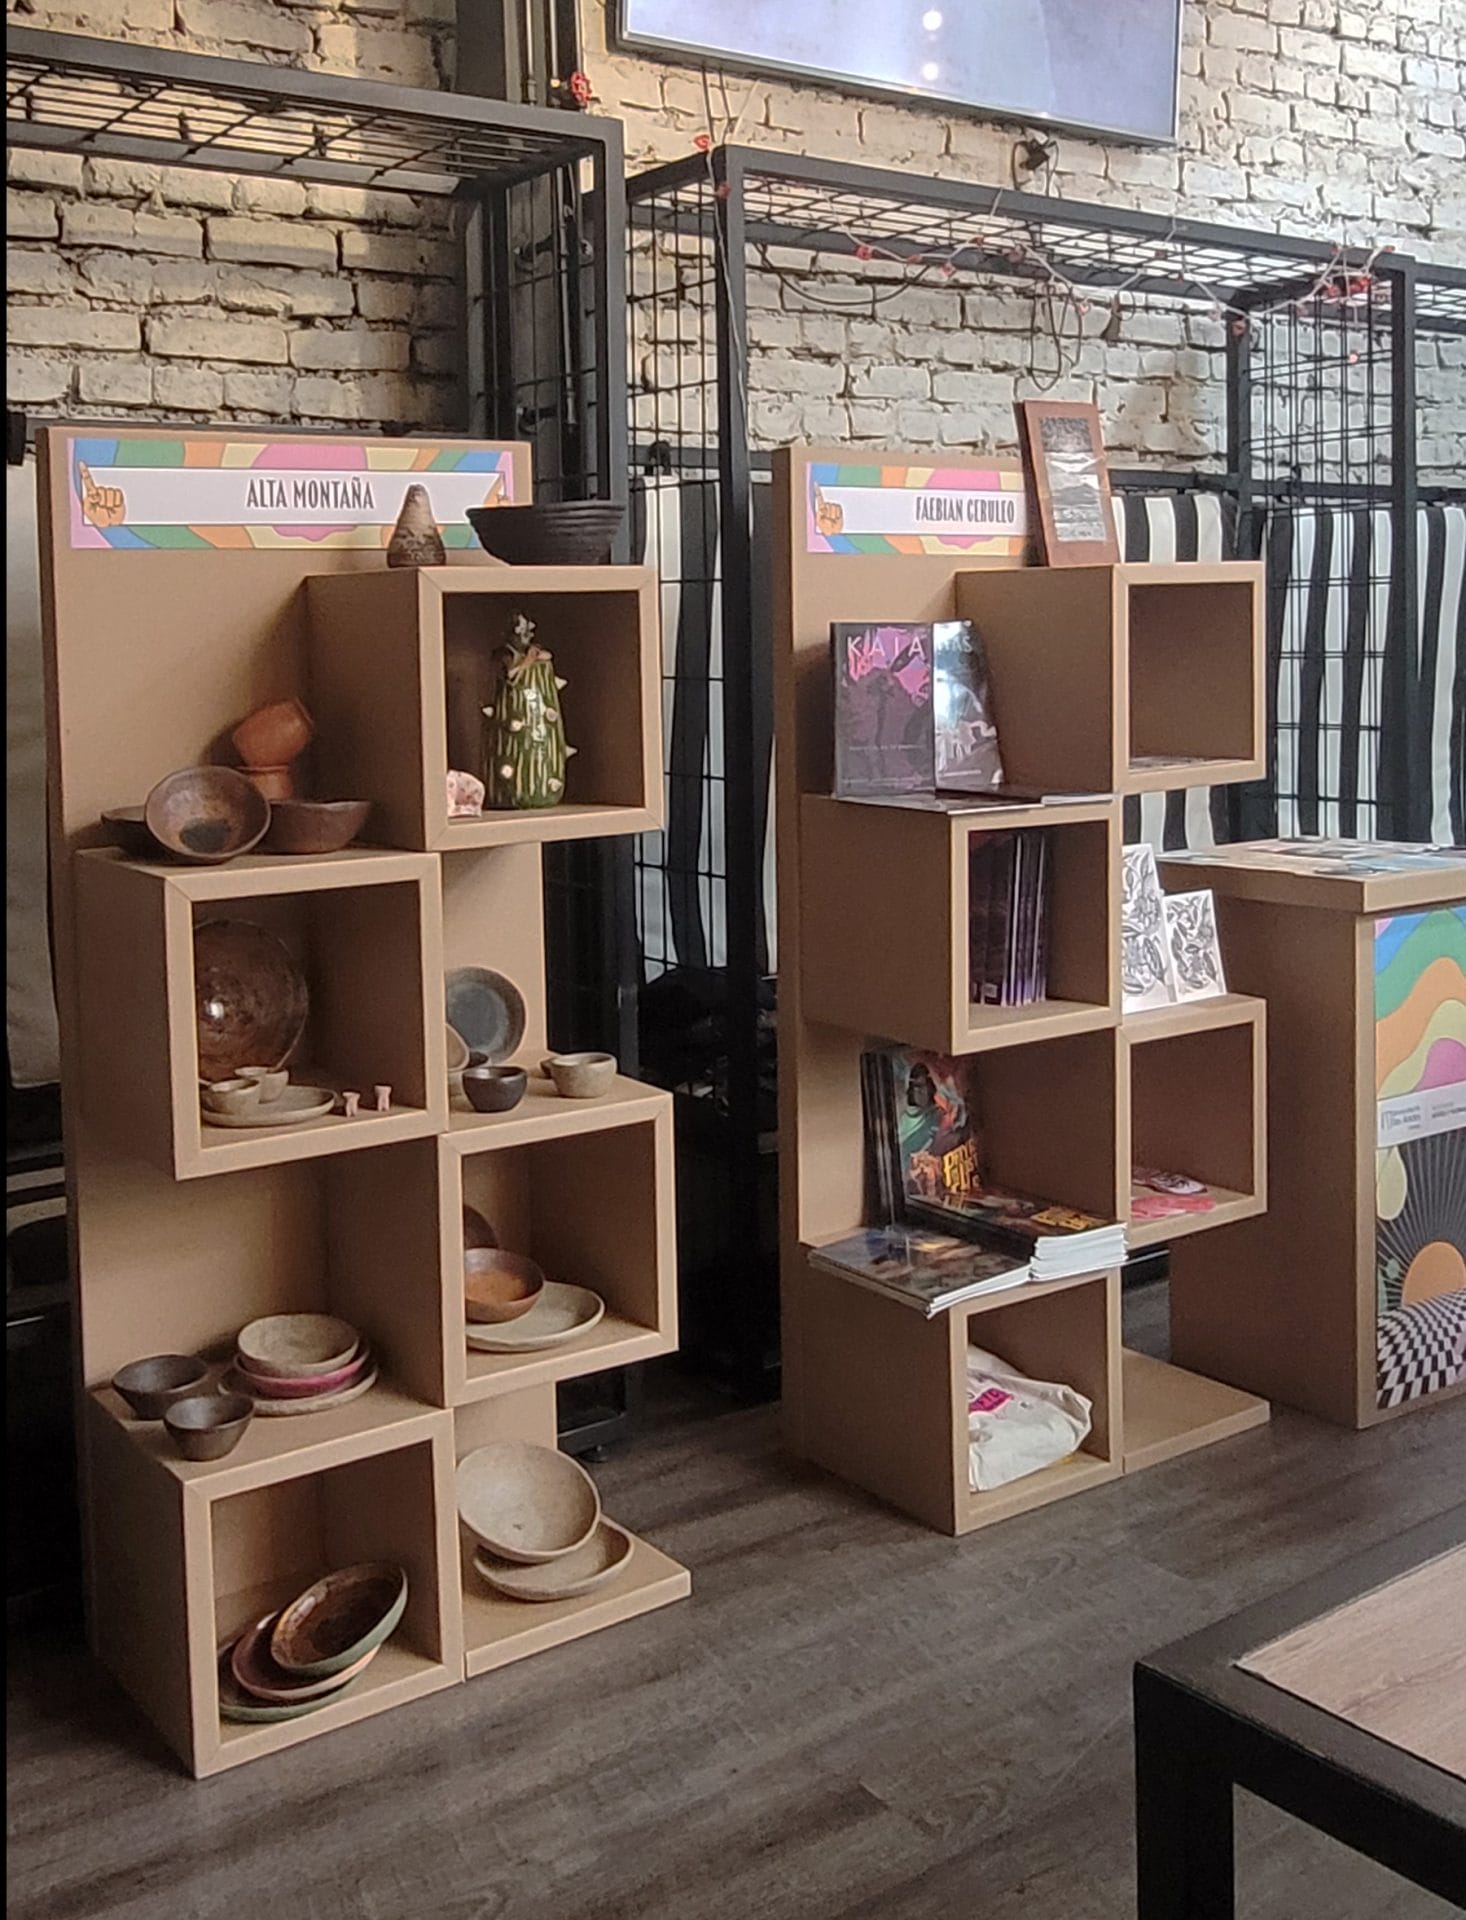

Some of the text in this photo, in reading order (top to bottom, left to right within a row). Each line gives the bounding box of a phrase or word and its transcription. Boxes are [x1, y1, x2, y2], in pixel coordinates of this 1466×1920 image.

[246, 476, 375, 509] ALTA MONTAÑA
[915, 496, 1015, 524] FAEBIAN CERULEO
